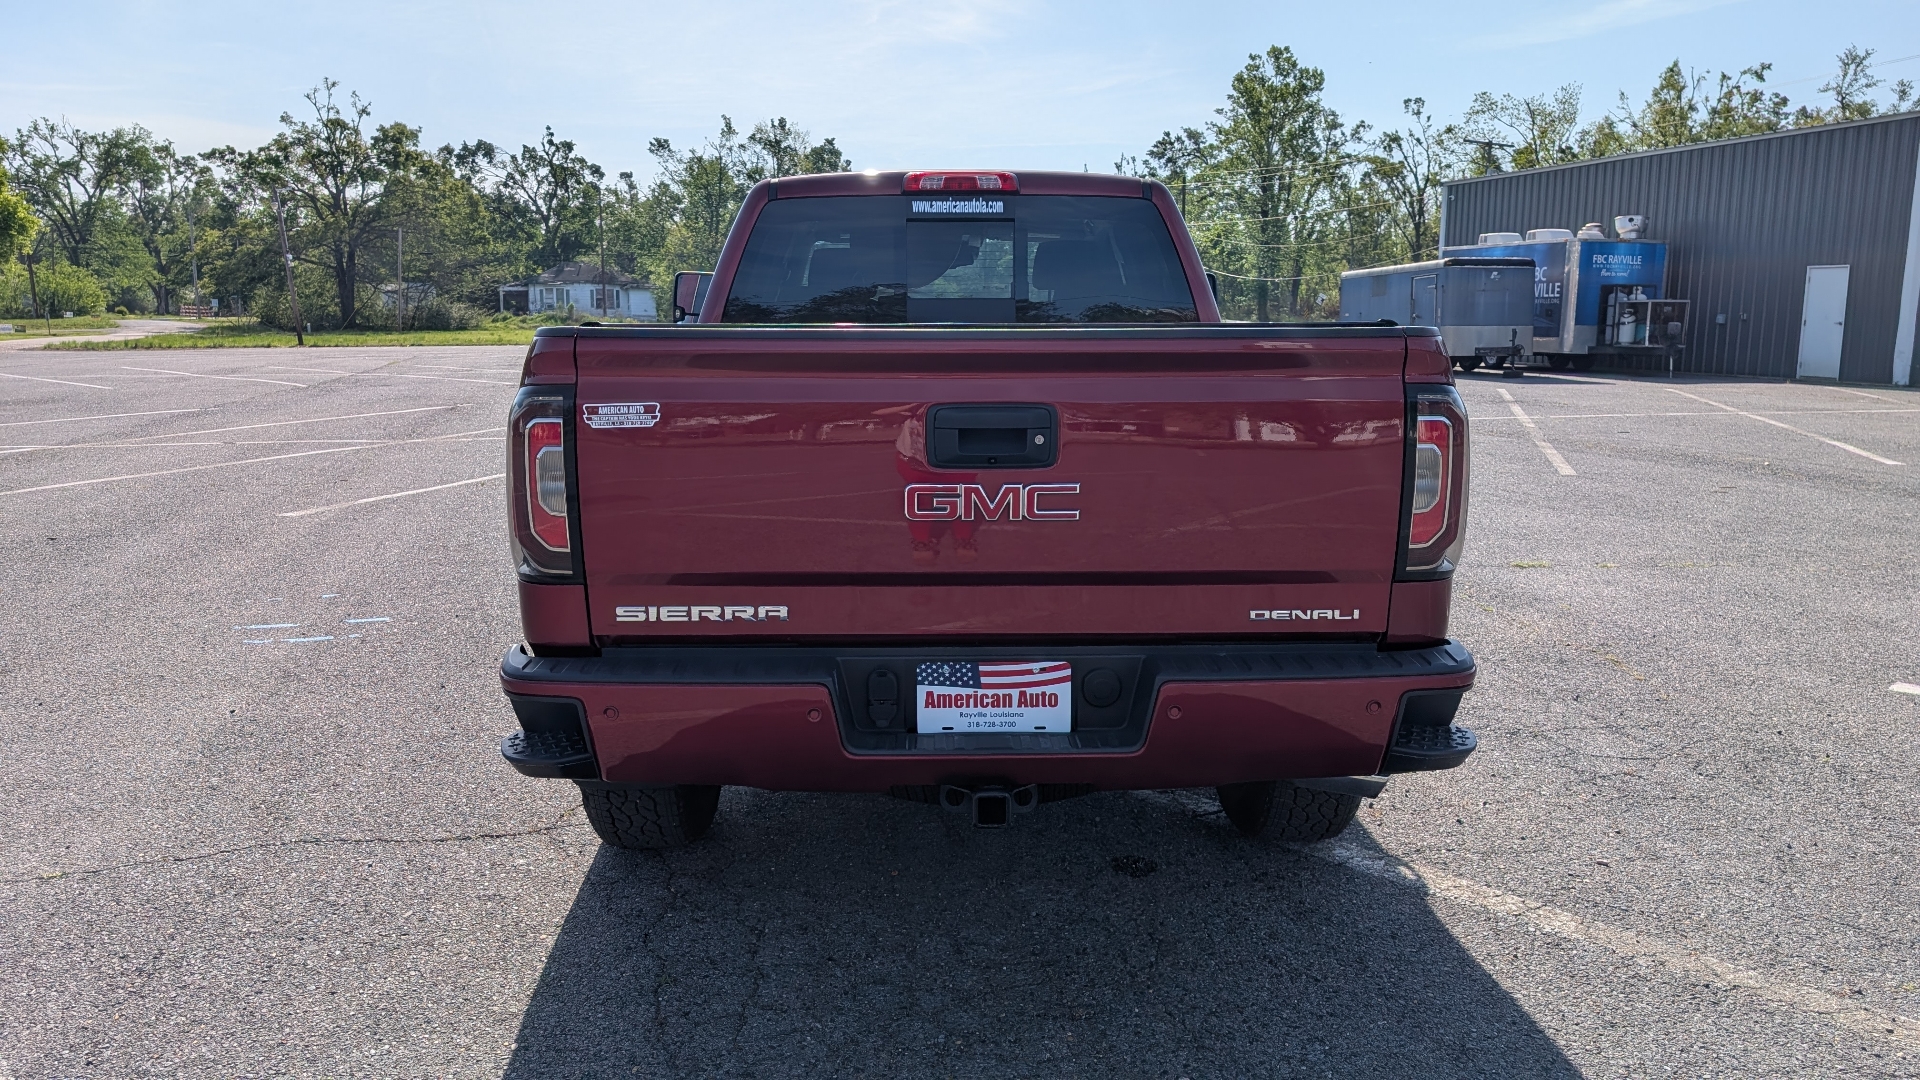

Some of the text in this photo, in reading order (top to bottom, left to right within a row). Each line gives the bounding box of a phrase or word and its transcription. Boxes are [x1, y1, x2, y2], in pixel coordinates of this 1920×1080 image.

[912, 197, 1004, 213] www.americanautola.com
[1592, 254, 1642, 265] FBC RAYVILLE
[1534, 266, 1548, 281] BC
[1534, 282, 1561, 298] VILLE
[598, 406, 644, 414] AMERICAN AUTO
[904, 483, 1080, 521] GMC
[615, 605, 789, 622] SIERRA
[1249, 609, 1360, 620] DENALI
[924, 690, 1059, 709] American Auto
[959, 711, 987, 719] Rayville
